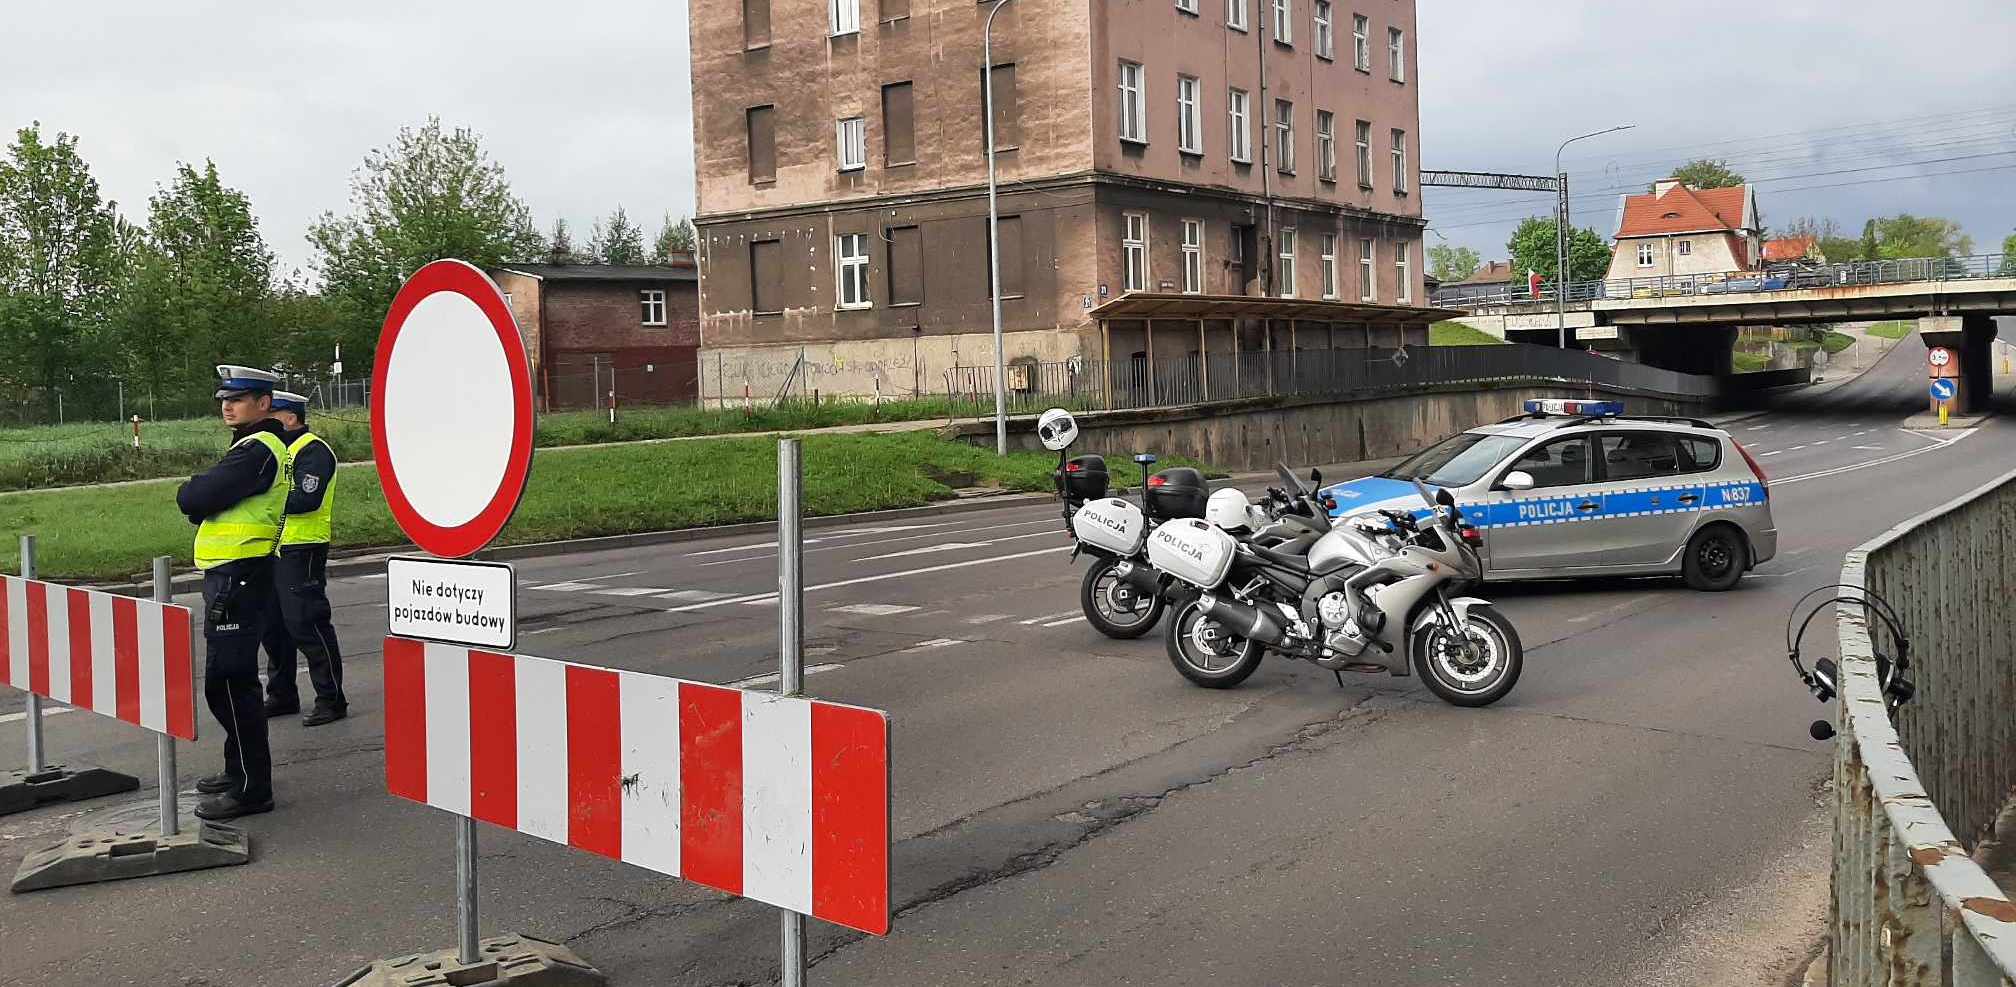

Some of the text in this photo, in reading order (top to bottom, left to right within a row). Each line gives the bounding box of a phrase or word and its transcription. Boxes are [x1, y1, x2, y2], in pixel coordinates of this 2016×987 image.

[1084, 509, 1126, 533] POLICJA
[1520, 501, 1573, 518] POLICJA
[1157, 530, 1203, 561] POLICJA
[412, 579, 484, 606] Nie dotyczy
[394, 603, 505, 633] pojazdów budowy
